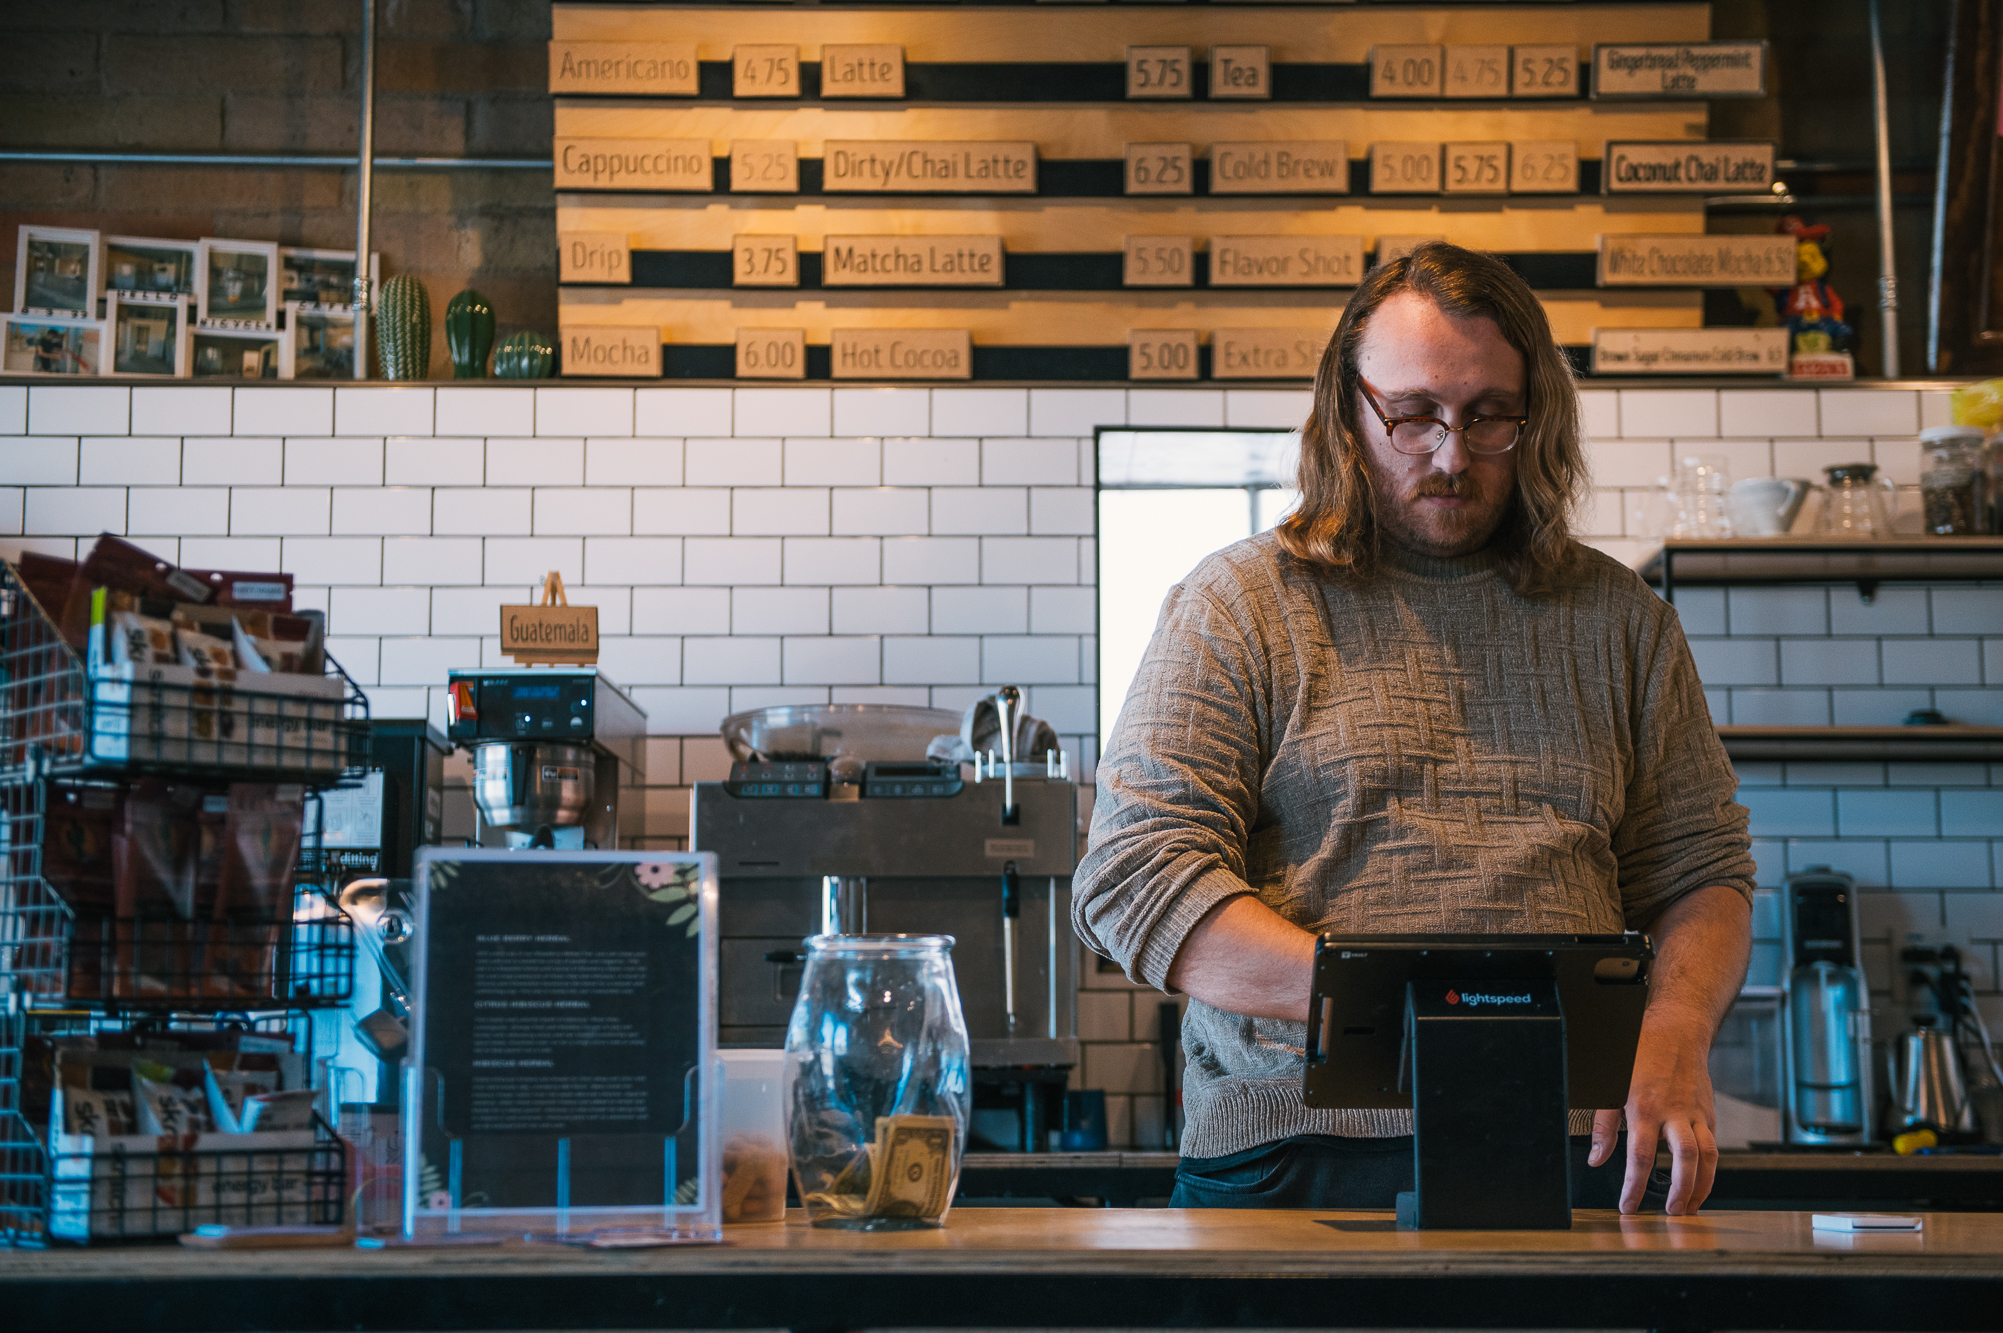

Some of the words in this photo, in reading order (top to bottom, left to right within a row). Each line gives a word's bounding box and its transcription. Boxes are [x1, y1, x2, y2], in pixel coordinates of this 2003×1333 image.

[559, 50, 690, 81] Americano
[742, 57, 791, 86] 4.75
[828, 54, 894, 83] Latte
[1135, 58, 1183, 88] 5.75
[1219, 57, 1259, 87] Tea
[1381, 57, 1436, 87] 4.00
[1452, 58, 1500, 87] 4.75
[1521, 57, 1571, 87] 5.25
[1681, 50, 1753, 76] Peppermint
[562, 145, 703, 183] Cappuccino
[740, 152, 789, 182] 5.25
[833, 150, 959, 187] Dirty/Chai
[964, 151, 1029, 180] Latte
[1134, 155, 1185, 184] 6.25
[1217, 151, 1271, 180] Cold
[1276, 151, 1338, 179] Brew
[1380, 153, 1434, 183] 5.00
[1453, 153, 1500, 184] 5.75
[1520, 153, 1571, 183] 6.25
[1615, 154, 1682, 183] Coconut
[1685, 154, 1720, 183] Chai
[1723, 156, 1767, 183] Latte
[571, 241, 623, 277] Drip
[741, 247, 788, 276] 3.75
[833, 245, 924, 275] Matcha
[929, 246, 993, 275] Latte
[1134, 246, 1185, 276] 5.50
[1218, 247, 1293, 277] Flavor
[1298, 247, 1353, 277] Shot
[570, 338, 650, 366] Mocha
[744, 341, 796, 369] 6.00
[842, 341, 882, 369] Hot
[889, 341, 960, 369] Cocoa
[1138, 342, 1190, 371] 5.00
[1223, 340, 1290, 369] Extra
[510, 614, 589, 643] Guatemala
[340, 852, 379, 868] ditting
[1461, 992, 1532, 1007] lightspeed
